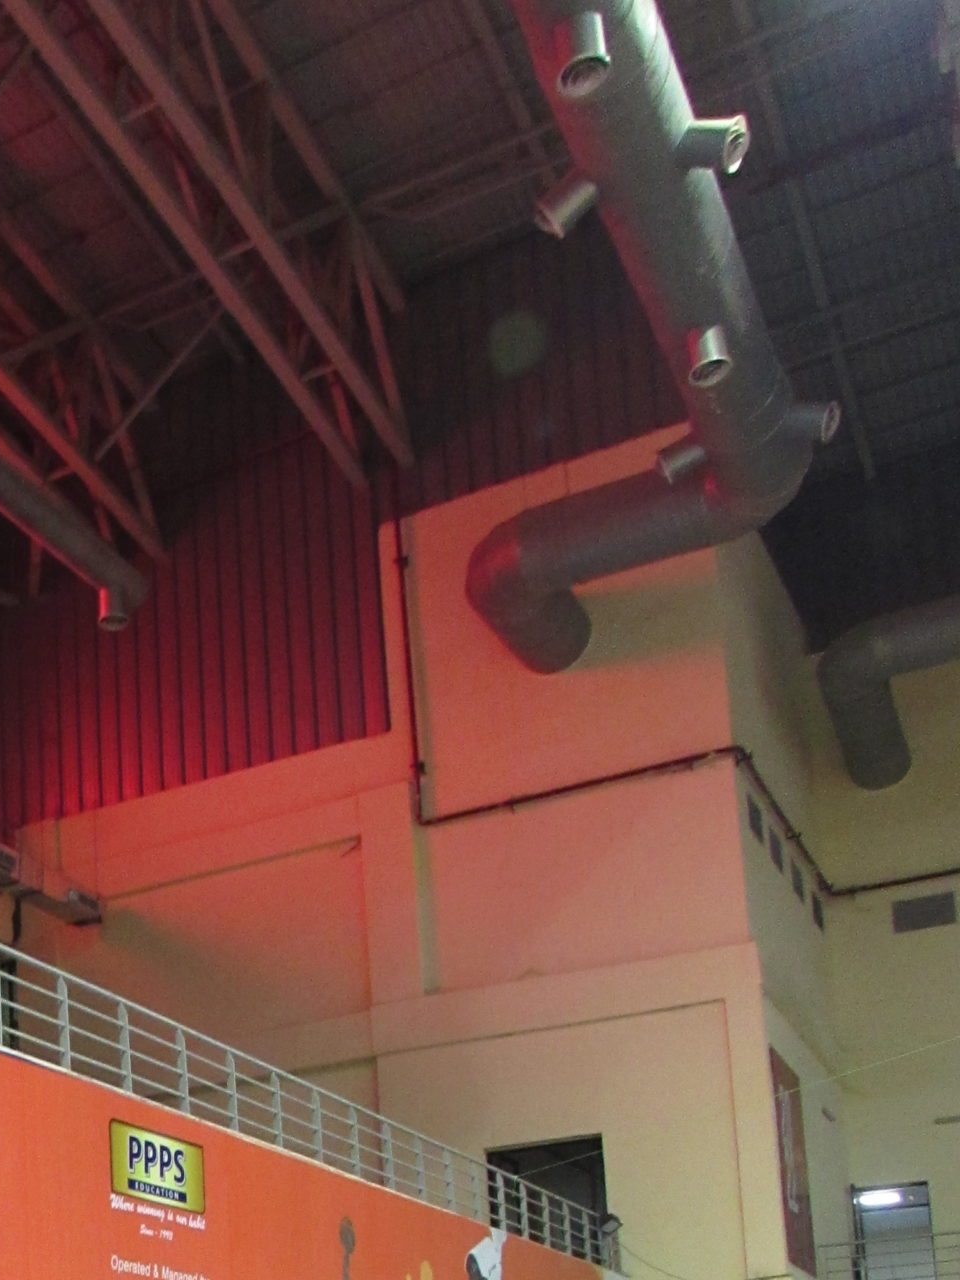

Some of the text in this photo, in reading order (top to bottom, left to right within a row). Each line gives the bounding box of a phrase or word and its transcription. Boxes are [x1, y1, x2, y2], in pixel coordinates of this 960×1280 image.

[128, 1135, 186, 1187] PPPS
[134, 1181, 180, 1201] EDUCATION
[110, 1254, 151, 1277] Operated
[153, 1264, 159, 1278] &
